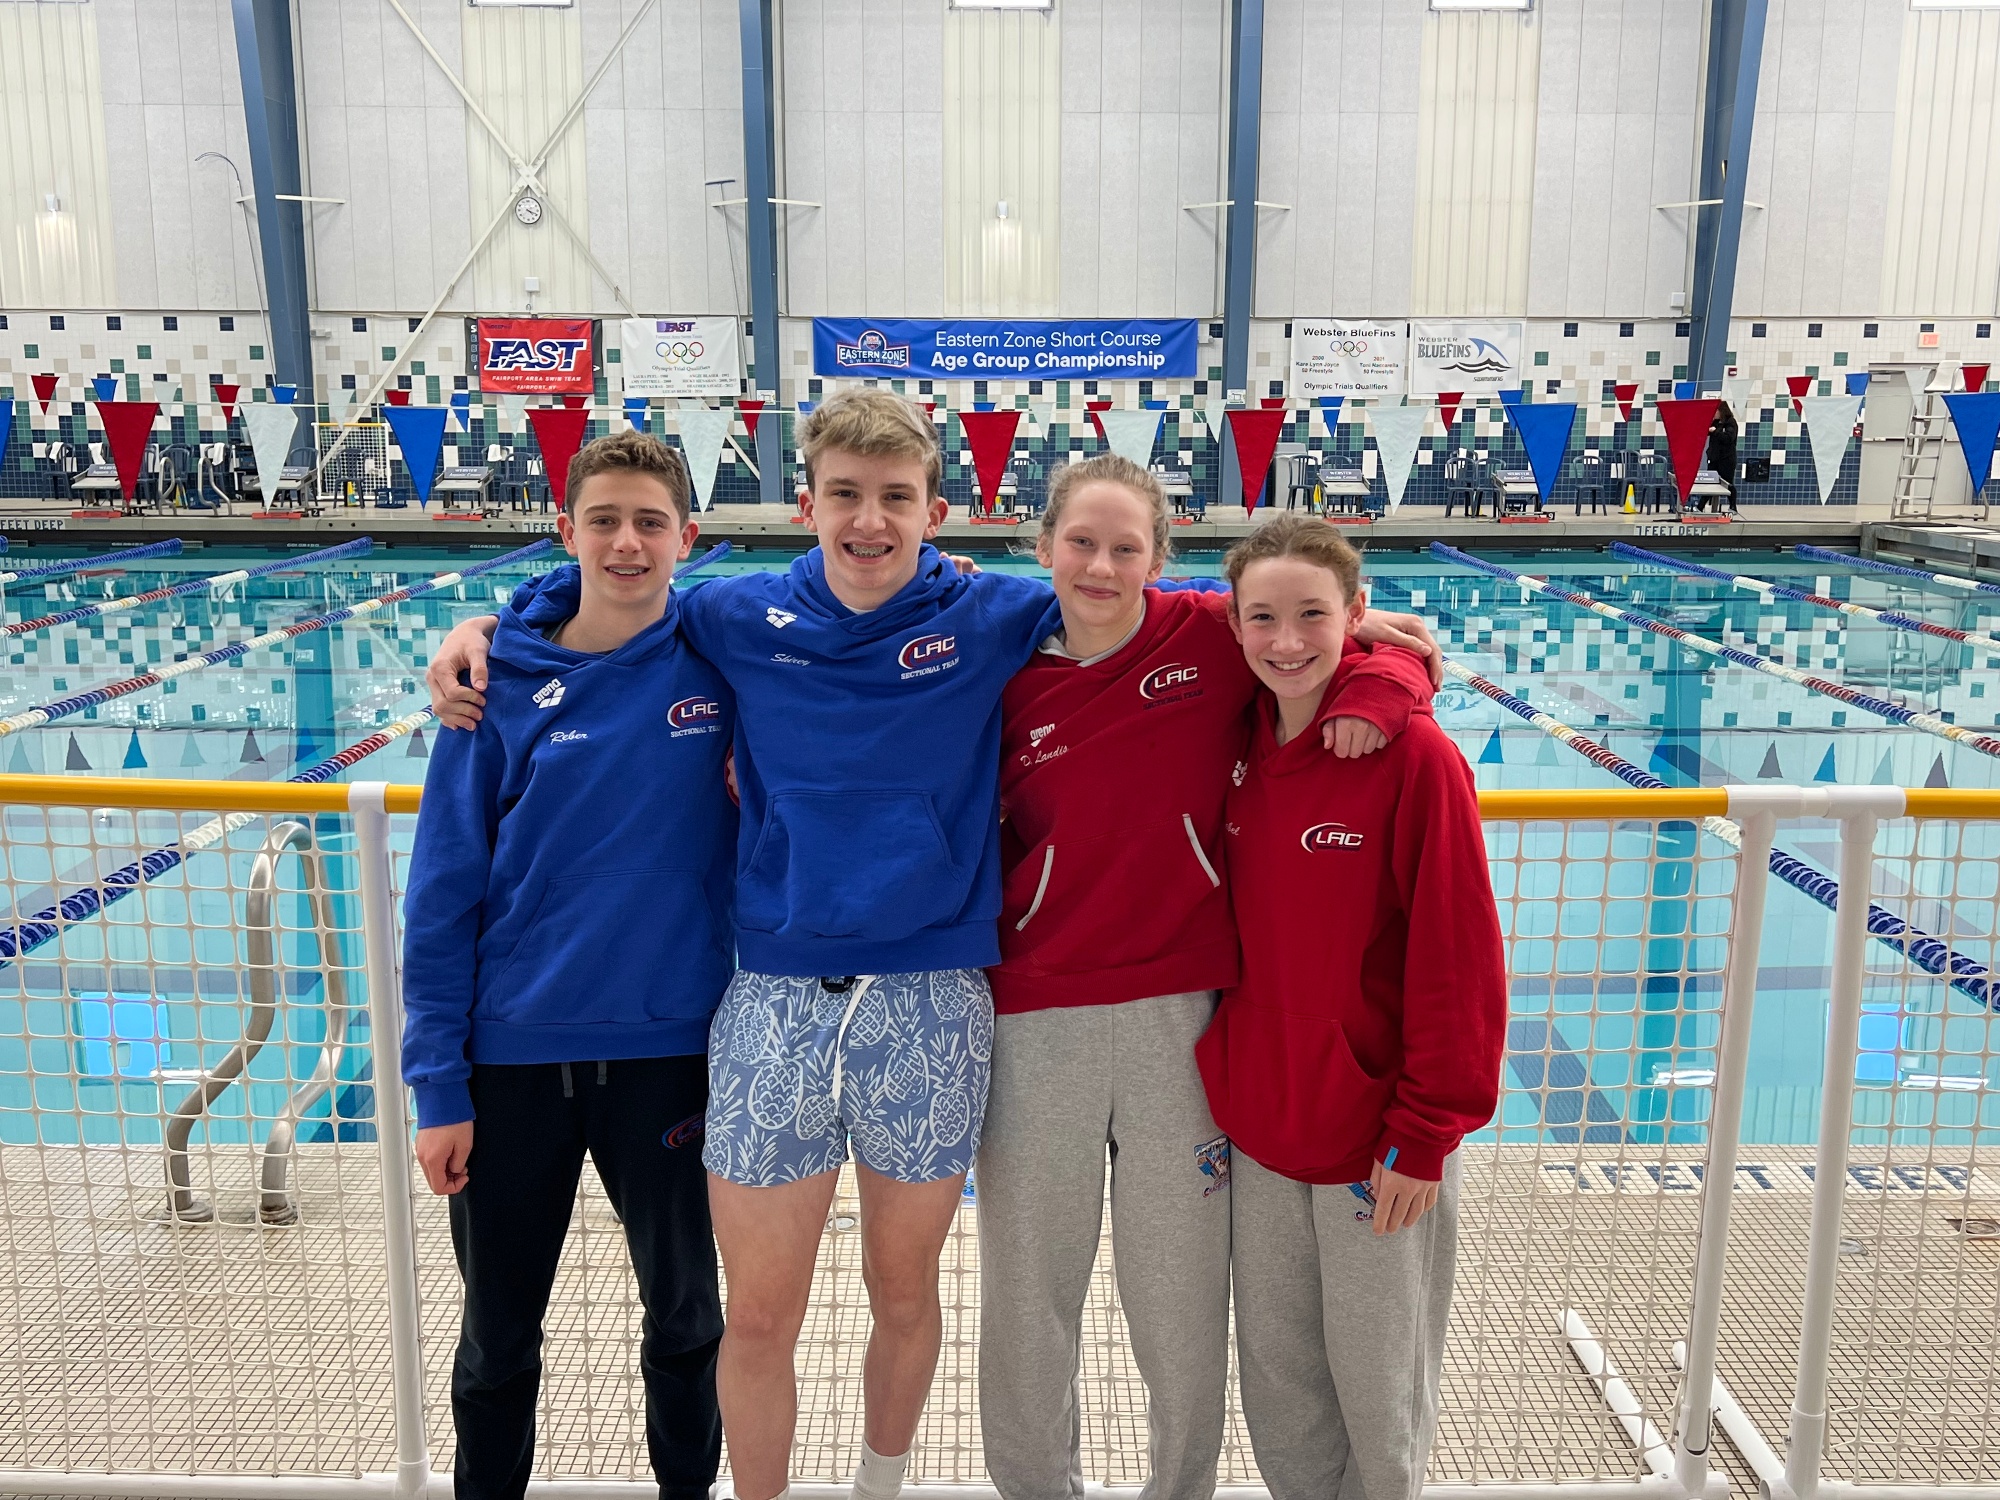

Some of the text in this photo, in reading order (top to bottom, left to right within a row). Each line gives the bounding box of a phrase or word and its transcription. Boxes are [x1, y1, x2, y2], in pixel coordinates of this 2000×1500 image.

[664, 322, 695, 332] FAST
[1304, 328, 1396, 338] Webster BlueFins
[936, 331, 1161, 347] Eastern Zone Short Course
[484, 338, 587, 371] FAST
[840, 348, 905, 361] EASTERN ZONE
[931, 351, 1166, 371] Age Group Championship
[0, 519, 64, 530] FEET DEEP
[1020, 513, 1027, 521] 6
[1195, 513, 1201, 521] 7
[524, 523, 556, 533] 7 FEE
[1636, 525, 1709, 536] 7 FEET DEEP
[914, 636, 955, 659] LAC
[900, 665, 941, 680] SECTIONAL
[941, 656, 960, 670] TEAM
[1154, 666, 1198, 689] LAC
[532, 678, 562, 704] arena
[680, 702, 719, 718] LAC
[550, 729, 589, 745] Reber
[670, 726, 707, 738] SECTIONAL
[1029, 723, 1056, 740] arena
[1034, 745, 1068, 764] Landis
[1316, 831, 1364, 846] LAC
